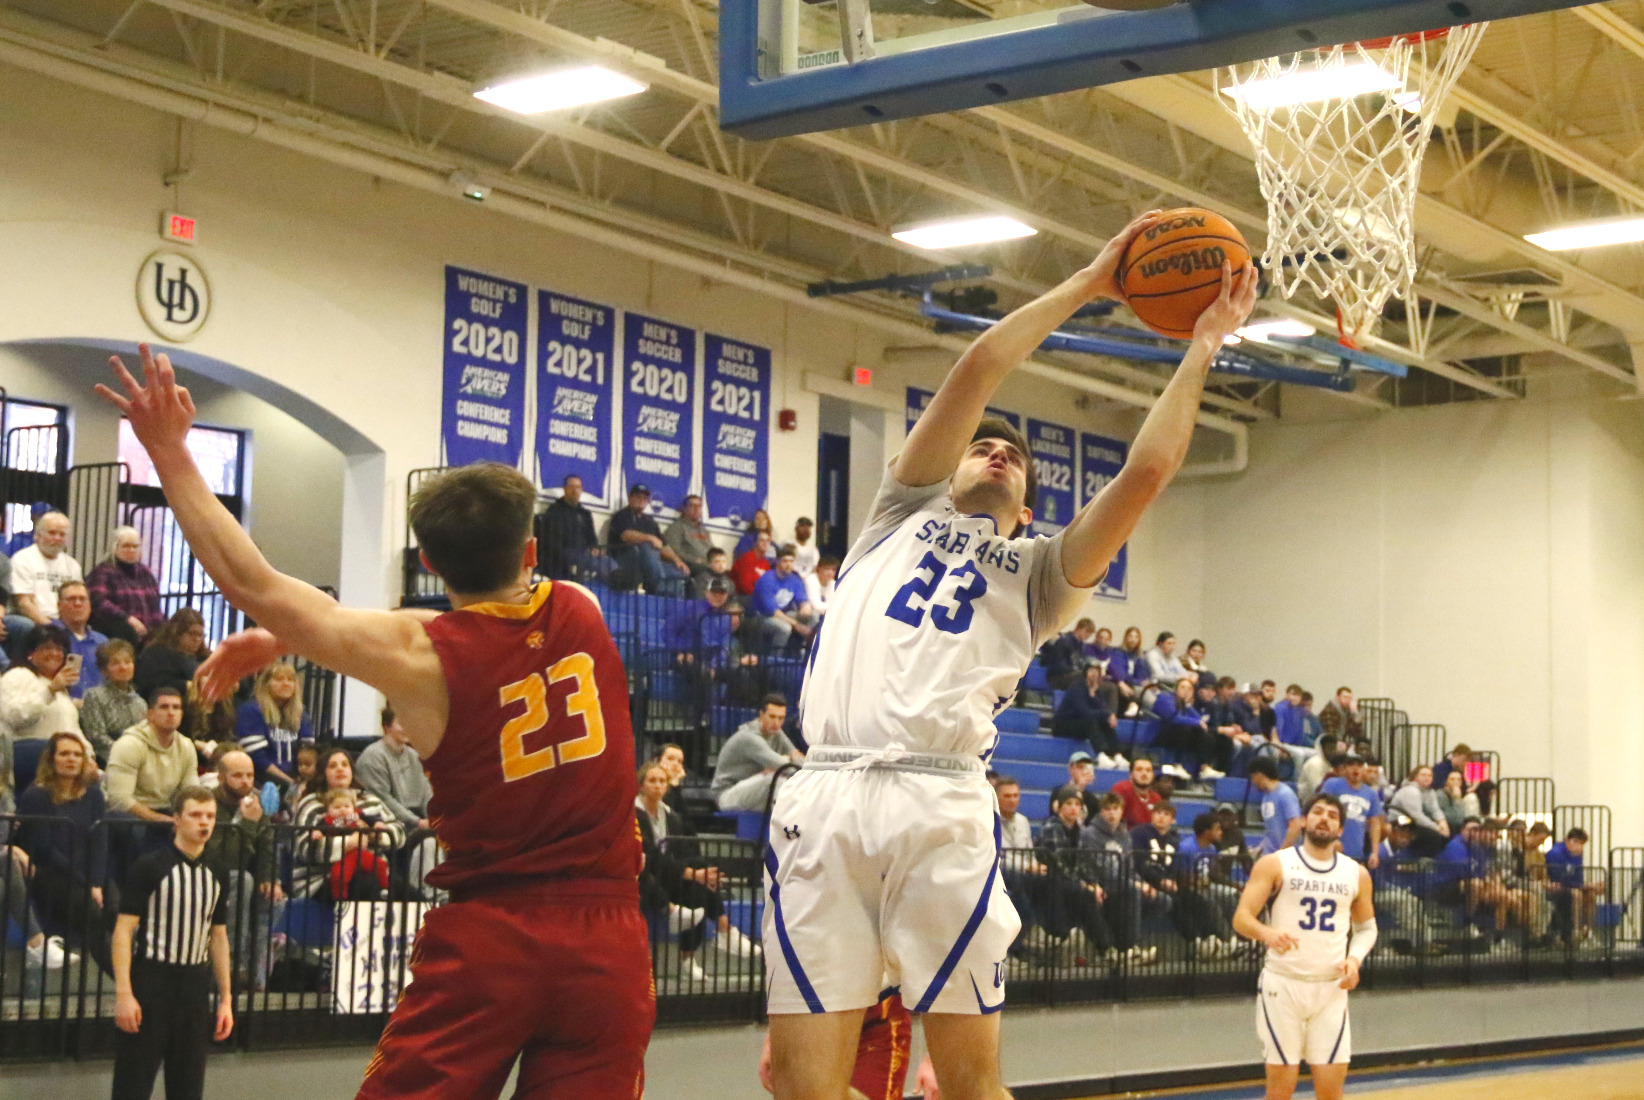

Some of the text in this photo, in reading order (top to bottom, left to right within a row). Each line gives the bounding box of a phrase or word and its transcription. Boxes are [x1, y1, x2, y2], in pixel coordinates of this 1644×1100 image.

[1140, 246, 1226, 279] Wilson
[457, 273, 517, 303] WOMEN'S
[471, 296, 503, 319] GOLF
[550, 297, 604, 326] WOMEN'S
[452, 318, 519, 364] 2020
[561, 318, 592, 340] GOLF
[643, 321, 678, 345] MEN'S
[546, 341, 605, 385] 2021
[638, 338, 682, 364] SOCCER
[722, 341, 755, 363] MEN'S
[630, 360, 688, 404] 2020
[717, 358, 759, 383] SOCCER
[456, 399, 511, 426] CONFERENCE
[710, 380, 761, 421] 2021
[457, 420, 508, 445] CHAMPIONS
[549, 418, 598, 443] CONFERENCE
[549, 438, 597, 462] CHAMPIONS
[634, 435, 681, 459] CONFERENCE
[634, 454, 681, 478] CHAMPIONS
[1032, 458, 1072, 492] 2022
[915, 519, 1020, 574] SARANS
[885, 550, 987, 635] 23
[499, 652, 607, 783] 23
[1290, 878, 1350, 897] SPARTANS
[1299, 896, 1337, 932] 32
